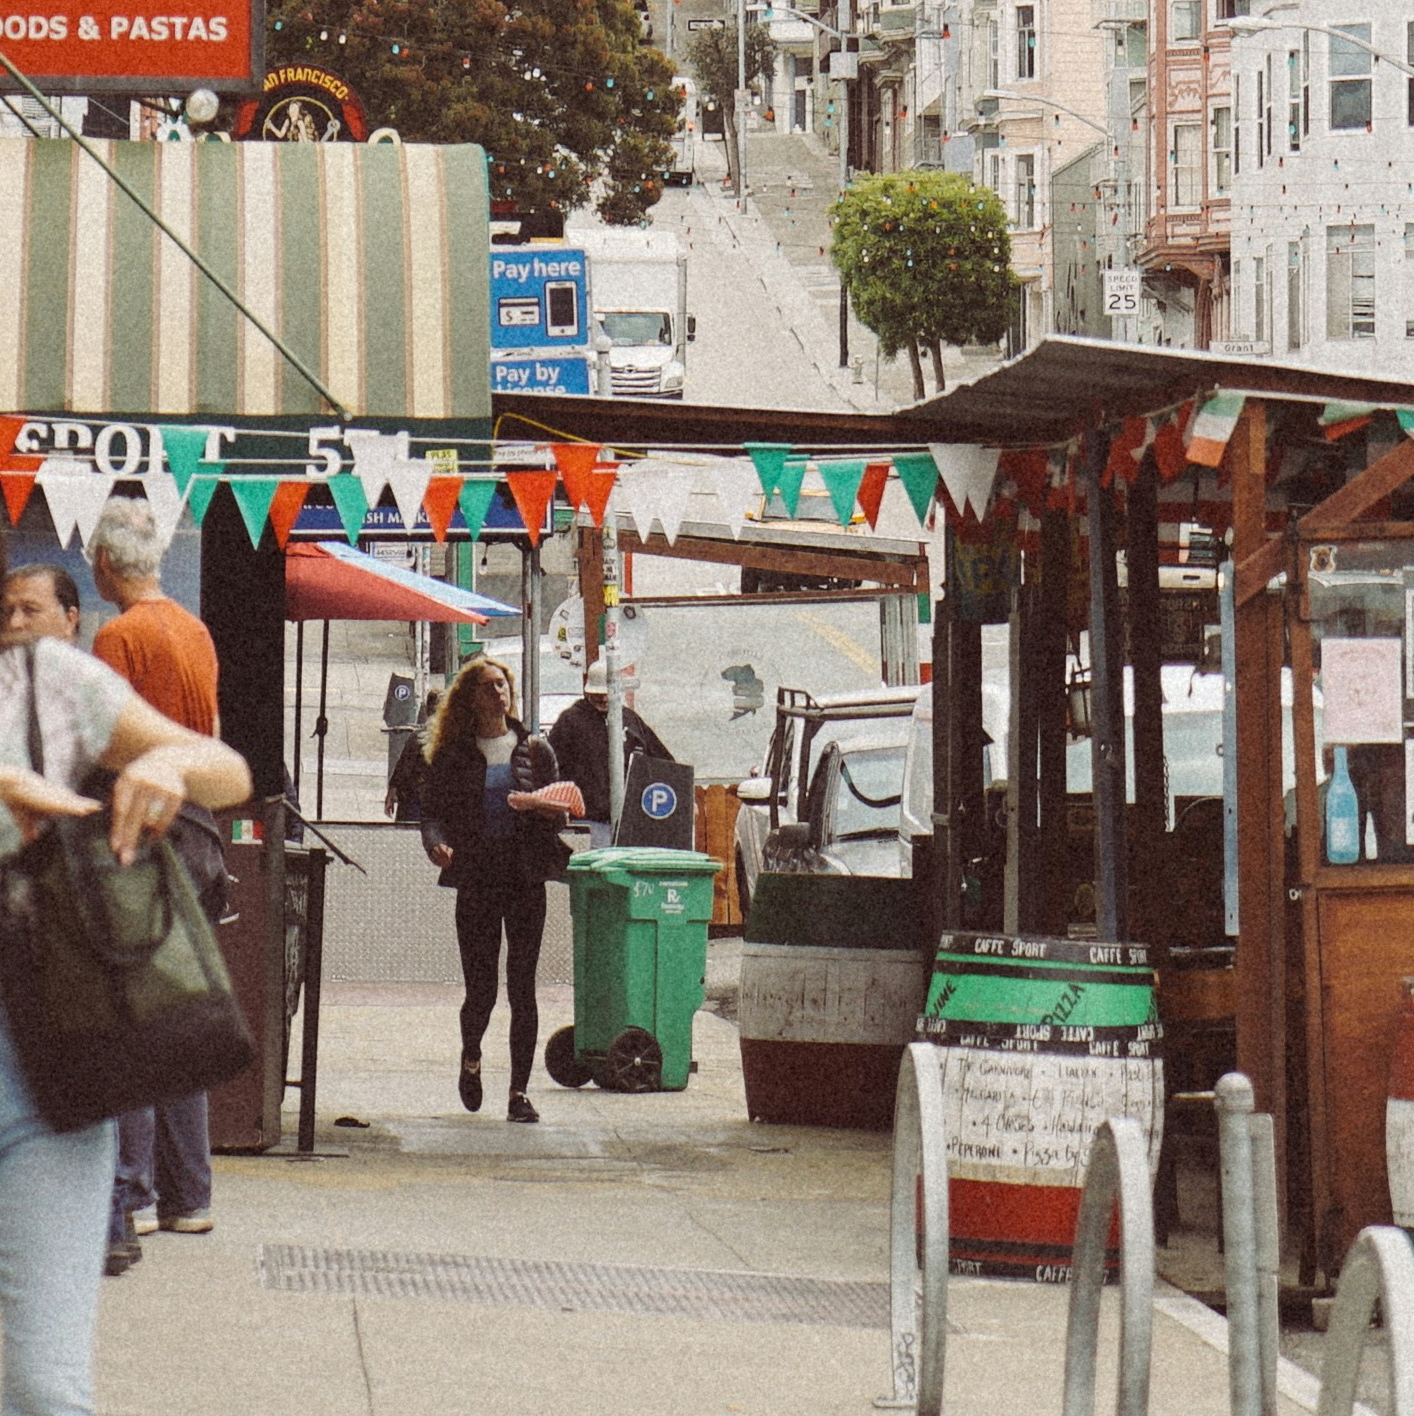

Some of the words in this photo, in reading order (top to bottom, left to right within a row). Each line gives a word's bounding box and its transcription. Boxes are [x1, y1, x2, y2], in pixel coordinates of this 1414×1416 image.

[77, 16, 102, 41] &
[109, 16, 228, 43] PASTAS
[279, 66, 350, 101] FRANCISCO
[492, 259, 531, 283] Pay
[534, 258, 581, 277] here
[1107, 275, 1137, 284] SPEED
[1109, 285, 1134, 293] LIMIT
[1108, 294, 1137, 310] 25
[1224, 343, 1254, 353] Grant
[495, 365, 529, 384] Pay
[535, 362, 560, 384] by
[651, 789, 668, 813] P
[974, 937, 1006, 955] CAFFE
[1011, 938, 1048, 959] SPORT
[1089, 947, 1123, 965] CAFFE
[1040, 983, 1085, 1027] PIZZA
[1089, 1040, 1121, 1057] CAFFE
[1035, 1264, 1073, 1284] CAFFE
